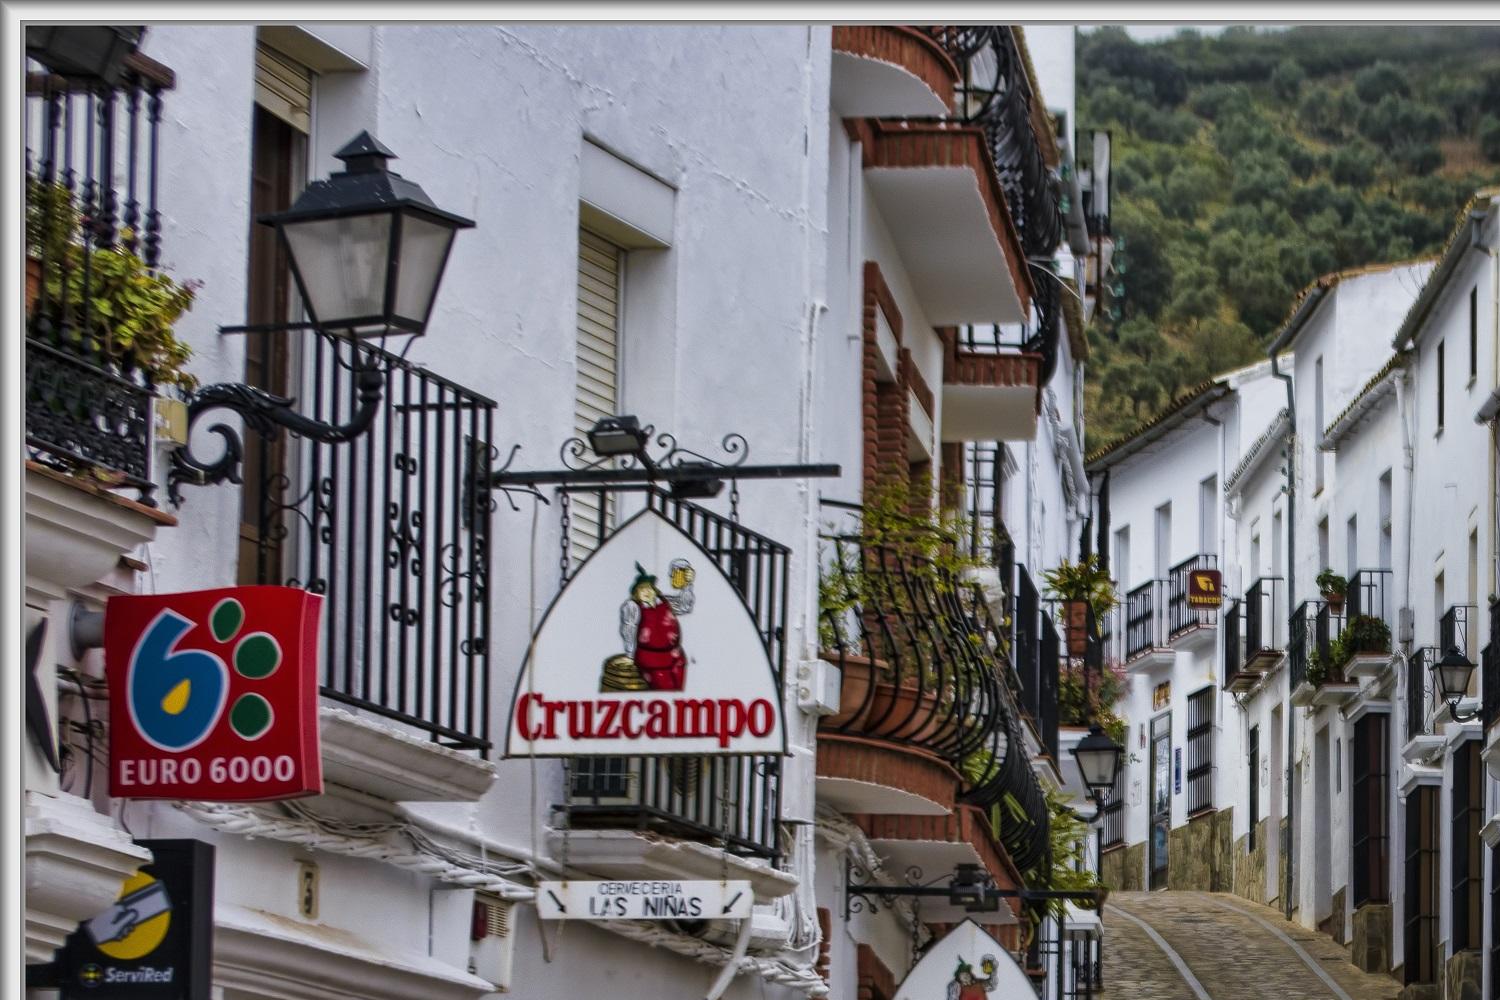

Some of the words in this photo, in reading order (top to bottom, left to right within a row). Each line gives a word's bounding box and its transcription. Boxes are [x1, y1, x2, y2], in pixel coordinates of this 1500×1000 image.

[516, 692, 776, 748] Cruzcampo
[119, 758, 201, 785] EURO
[209, 755, 296, 783] 6000
[589, 896, 628, 917] LAS
[641, 895, 702, 917] NIÑAS
[104, 966, 174, 982] ServiRed
